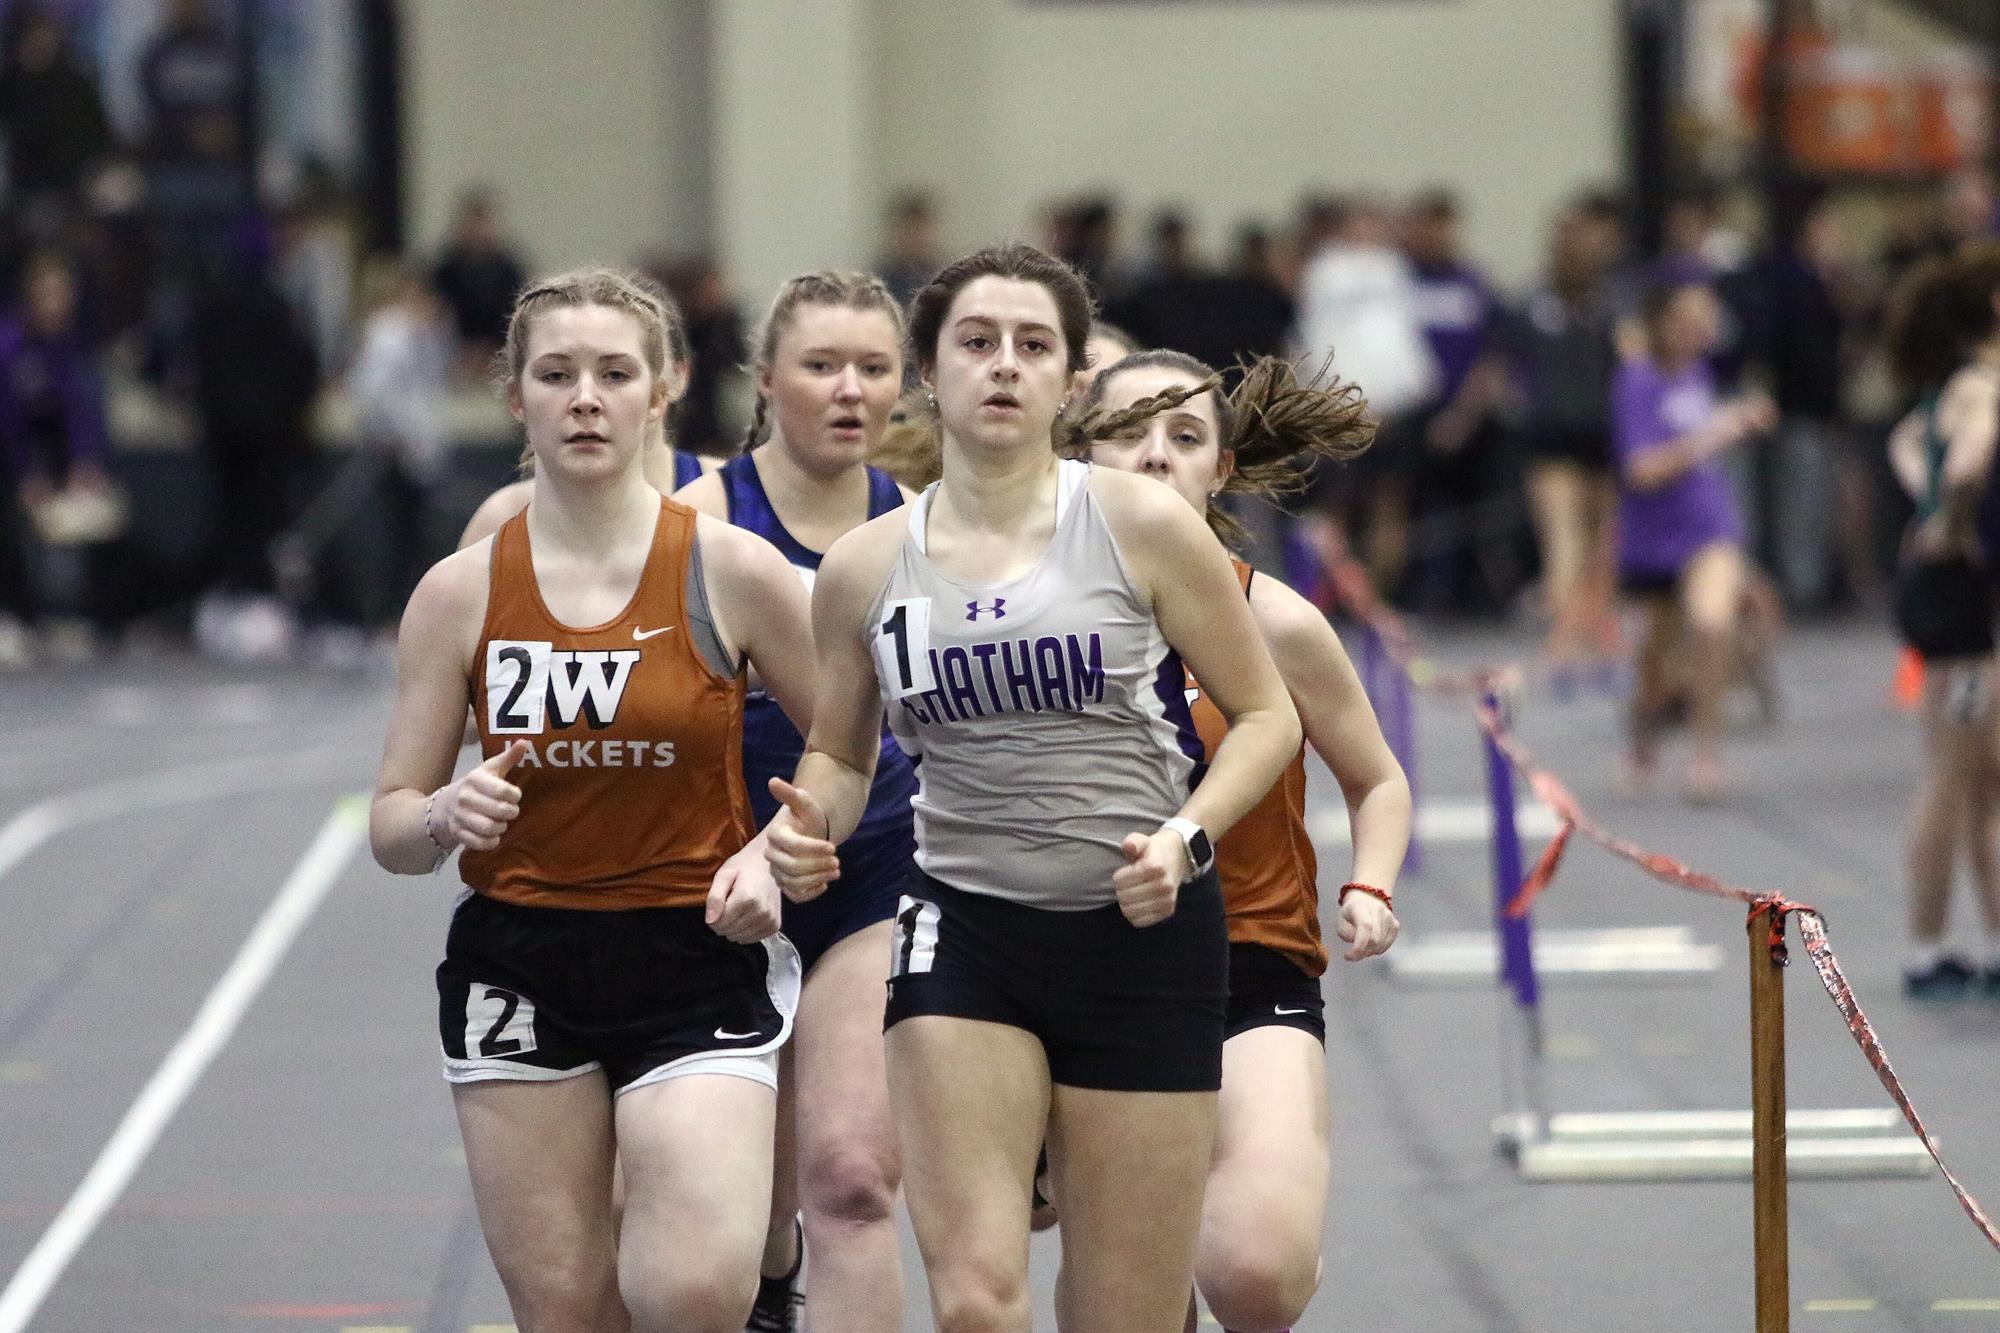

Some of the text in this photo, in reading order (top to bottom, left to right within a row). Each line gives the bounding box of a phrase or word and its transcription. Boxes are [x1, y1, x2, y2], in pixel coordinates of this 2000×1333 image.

[497, 646, 533, 728] 2
[882, 605, 913, 690] 1
[545, 649, 641, 730] W
[898, 903, 924, 975] 1
[479, 988, 522, 1057] 2
